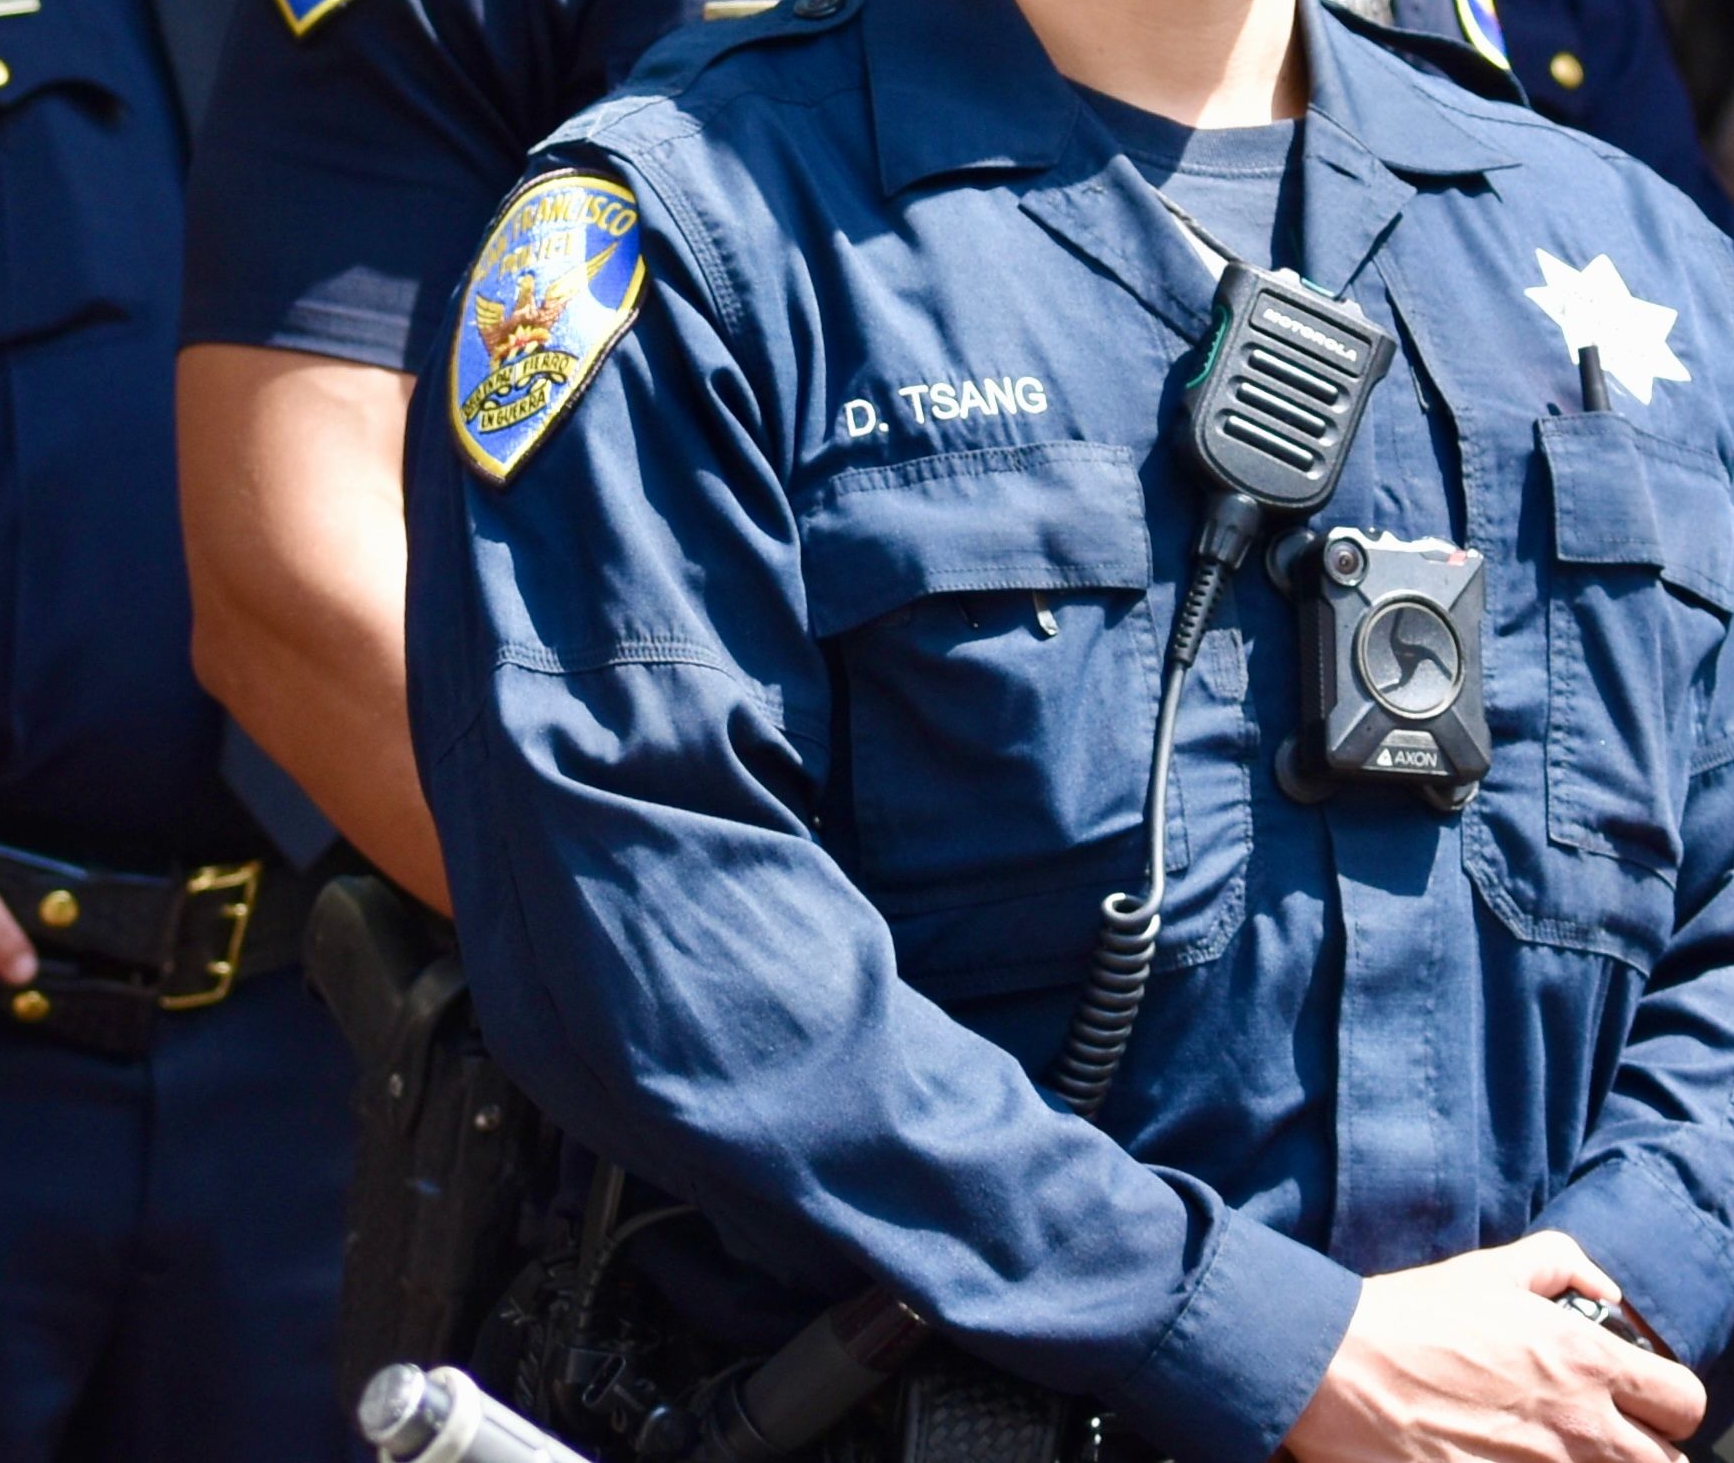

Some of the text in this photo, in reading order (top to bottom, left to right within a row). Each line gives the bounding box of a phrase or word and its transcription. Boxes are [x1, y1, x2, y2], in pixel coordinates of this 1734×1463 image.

[512, 192, 637, 236] FRANCISCO
[1263, 308, 1357, 362] MOTOROLA
[522, 353, 570, 374] FIERRO
[496, 391, 546, 424] GUERRA
[845, 376, 1048, 437] D. TSANG
[1394, 750, 1437, 767] AXON
